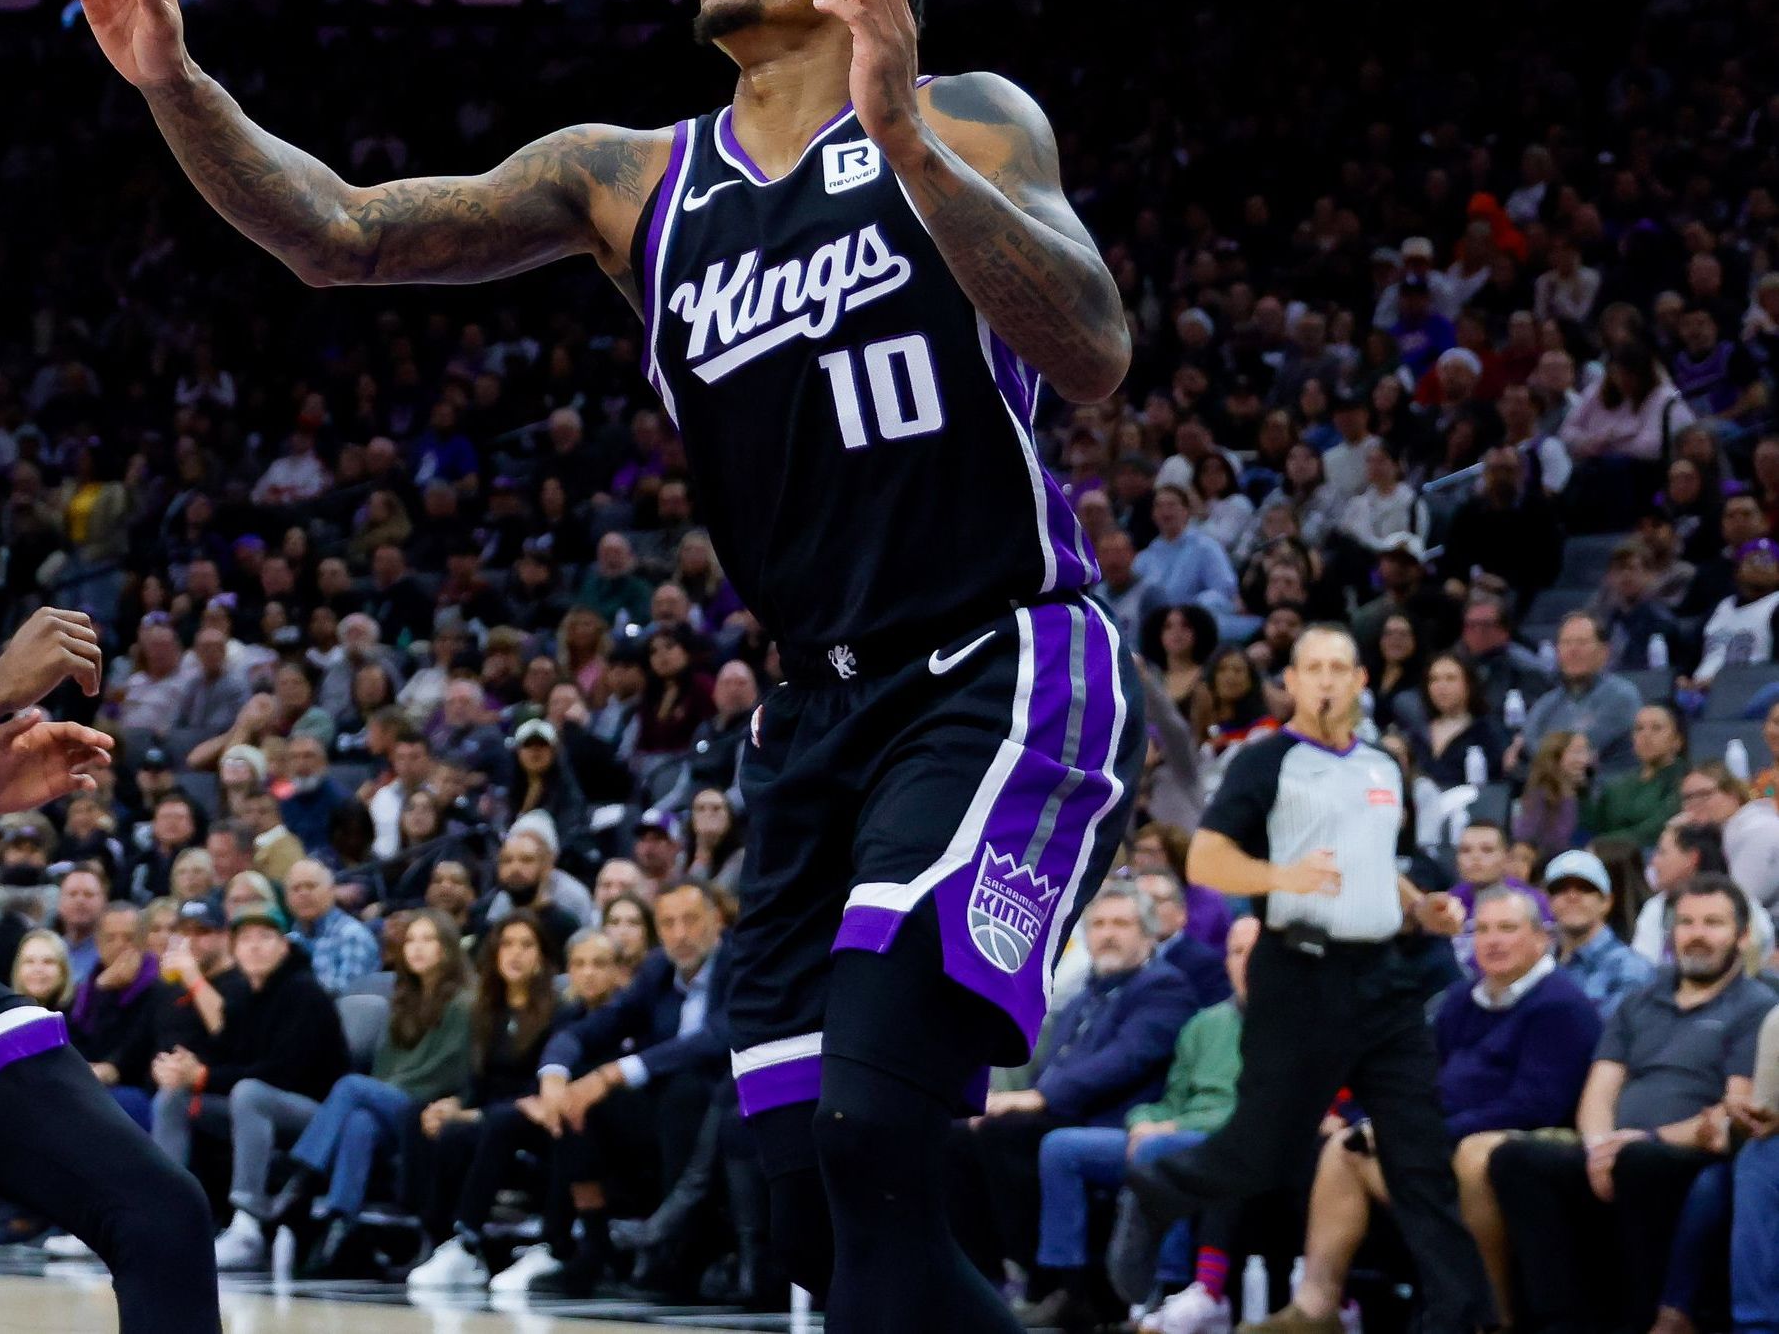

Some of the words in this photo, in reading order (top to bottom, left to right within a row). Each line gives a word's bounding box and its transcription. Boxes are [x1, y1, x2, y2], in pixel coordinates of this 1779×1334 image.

[837, 145, 870, 174] R
[668, 223, 912, 384] Kings
[818, 334, 944, 450] 10
[973, 888, 1040, 943] KINGS
